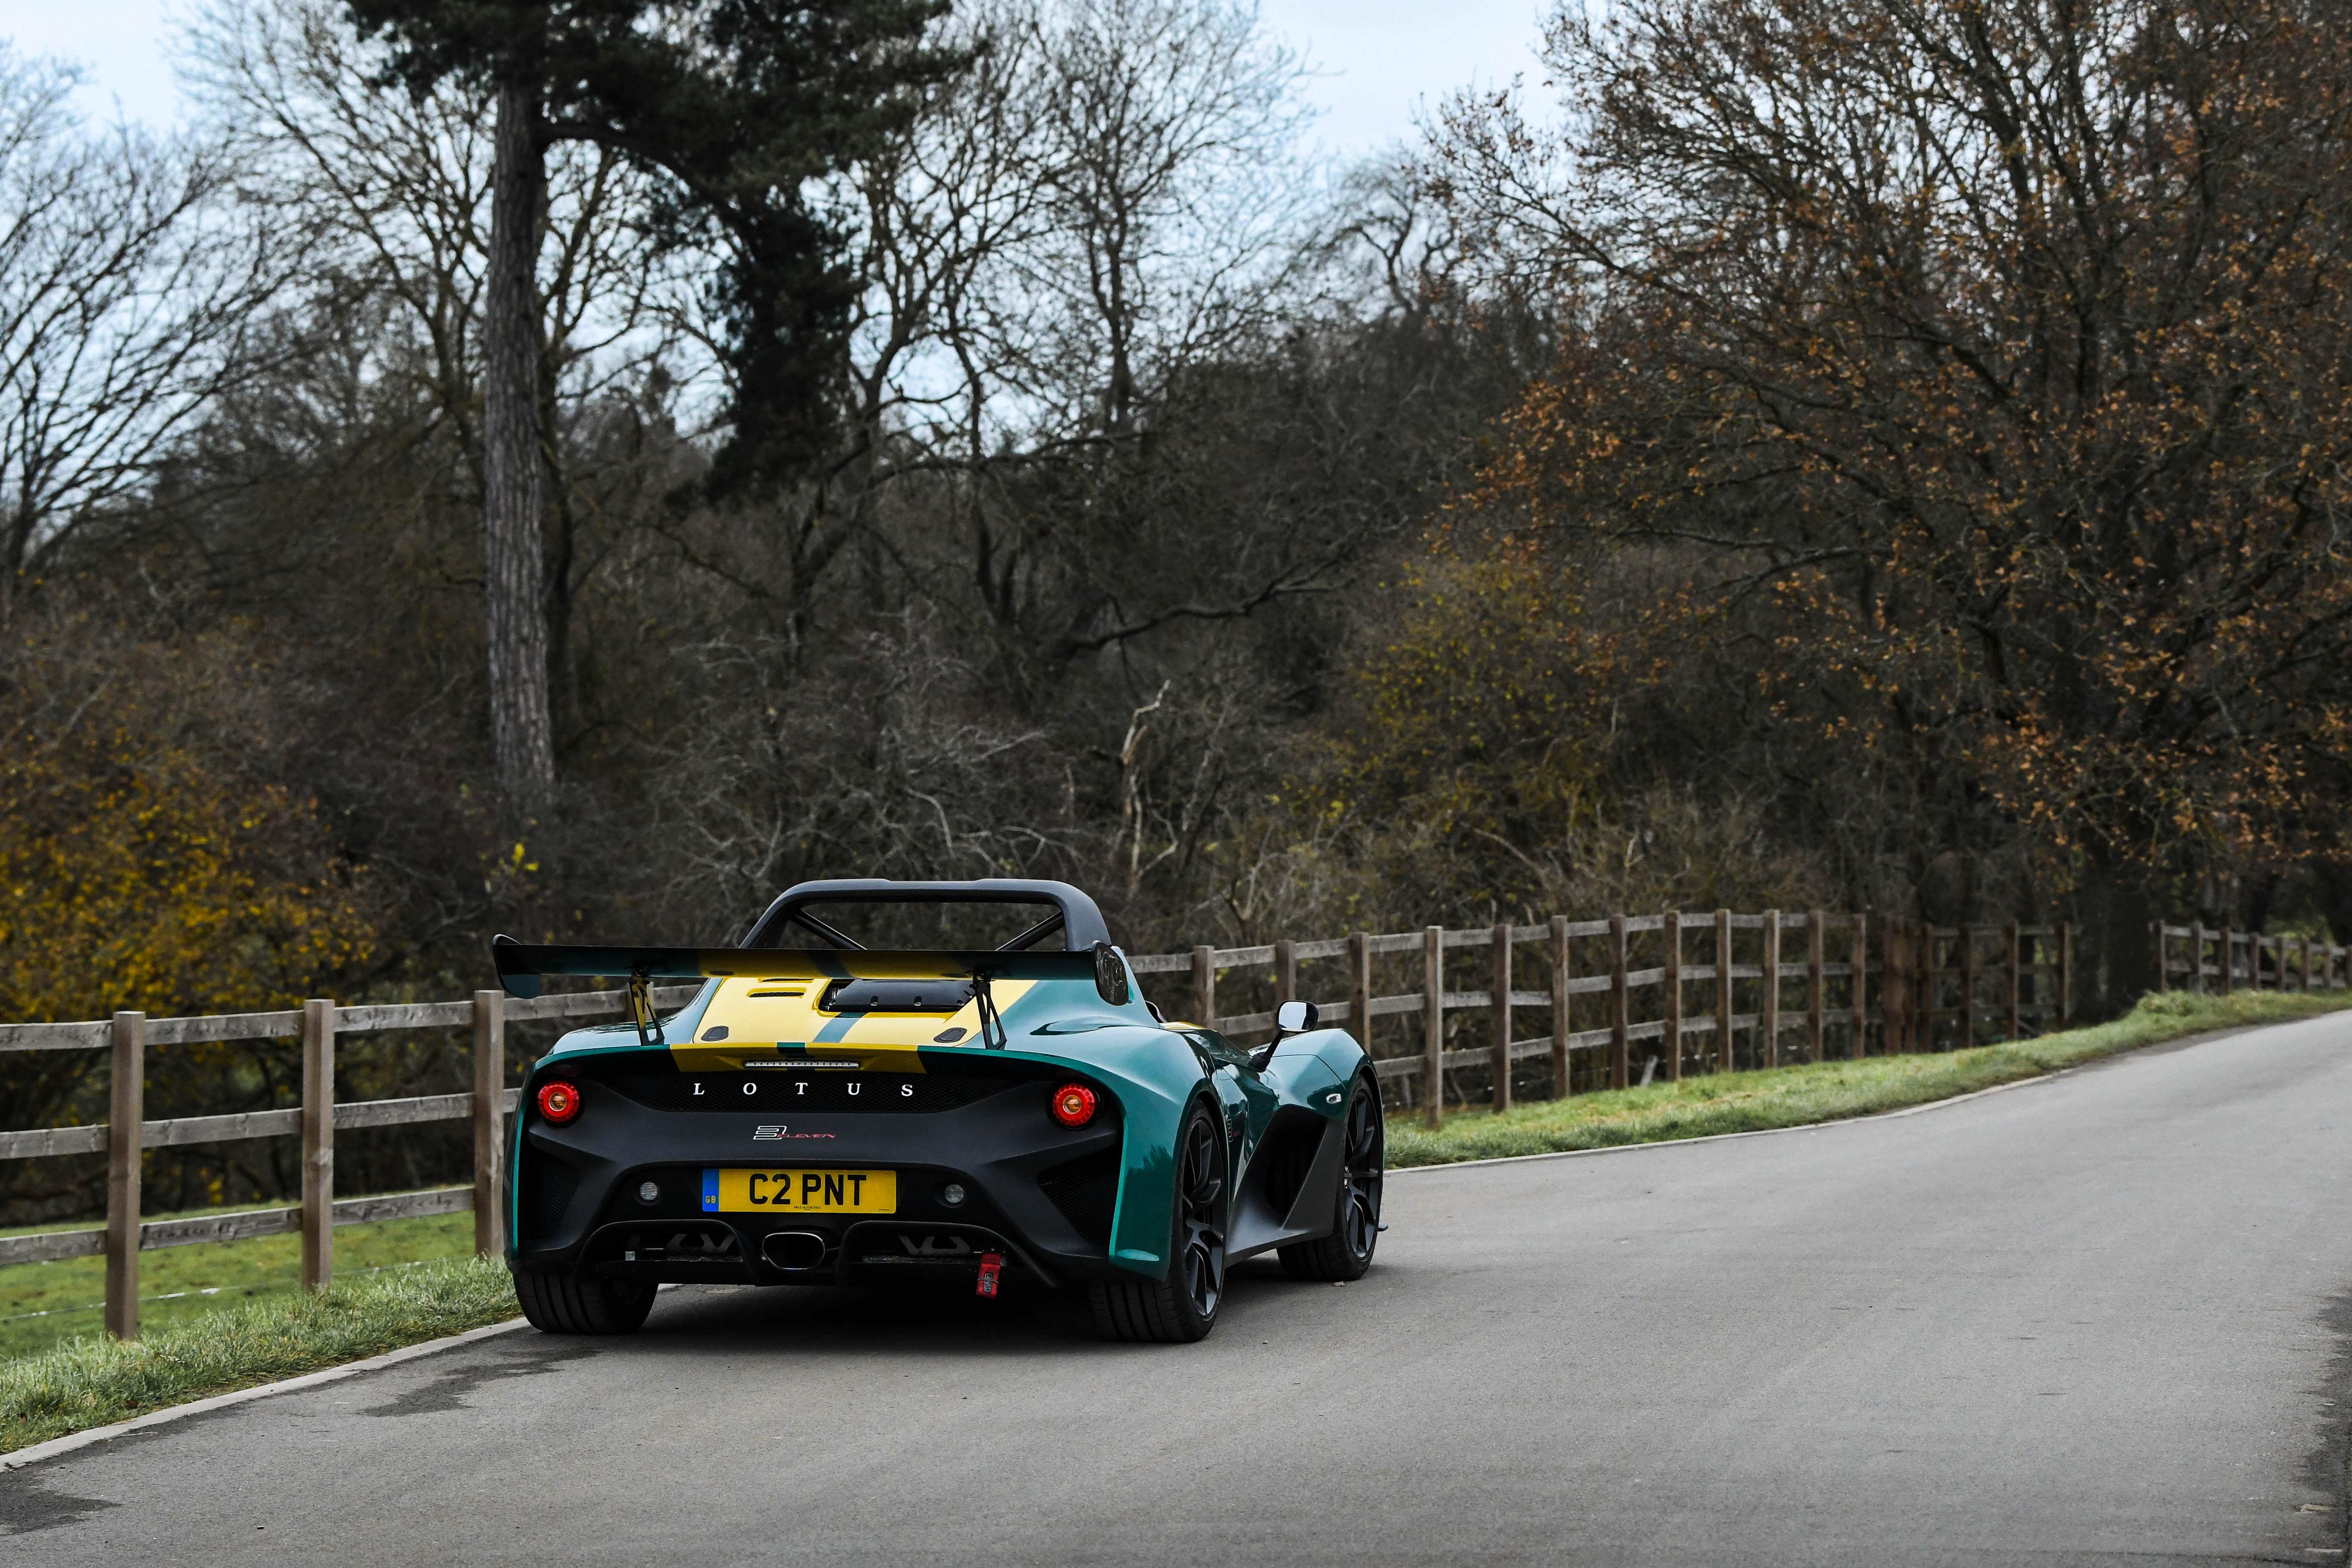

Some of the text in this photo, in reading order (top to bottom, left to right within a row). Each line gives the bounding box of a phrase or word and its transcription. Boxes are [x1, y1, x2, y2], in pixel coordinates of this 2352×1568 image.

[693, 1083, 913, 1096] LOTUS
[749, 1173, 867, 1206] C2 PNT
